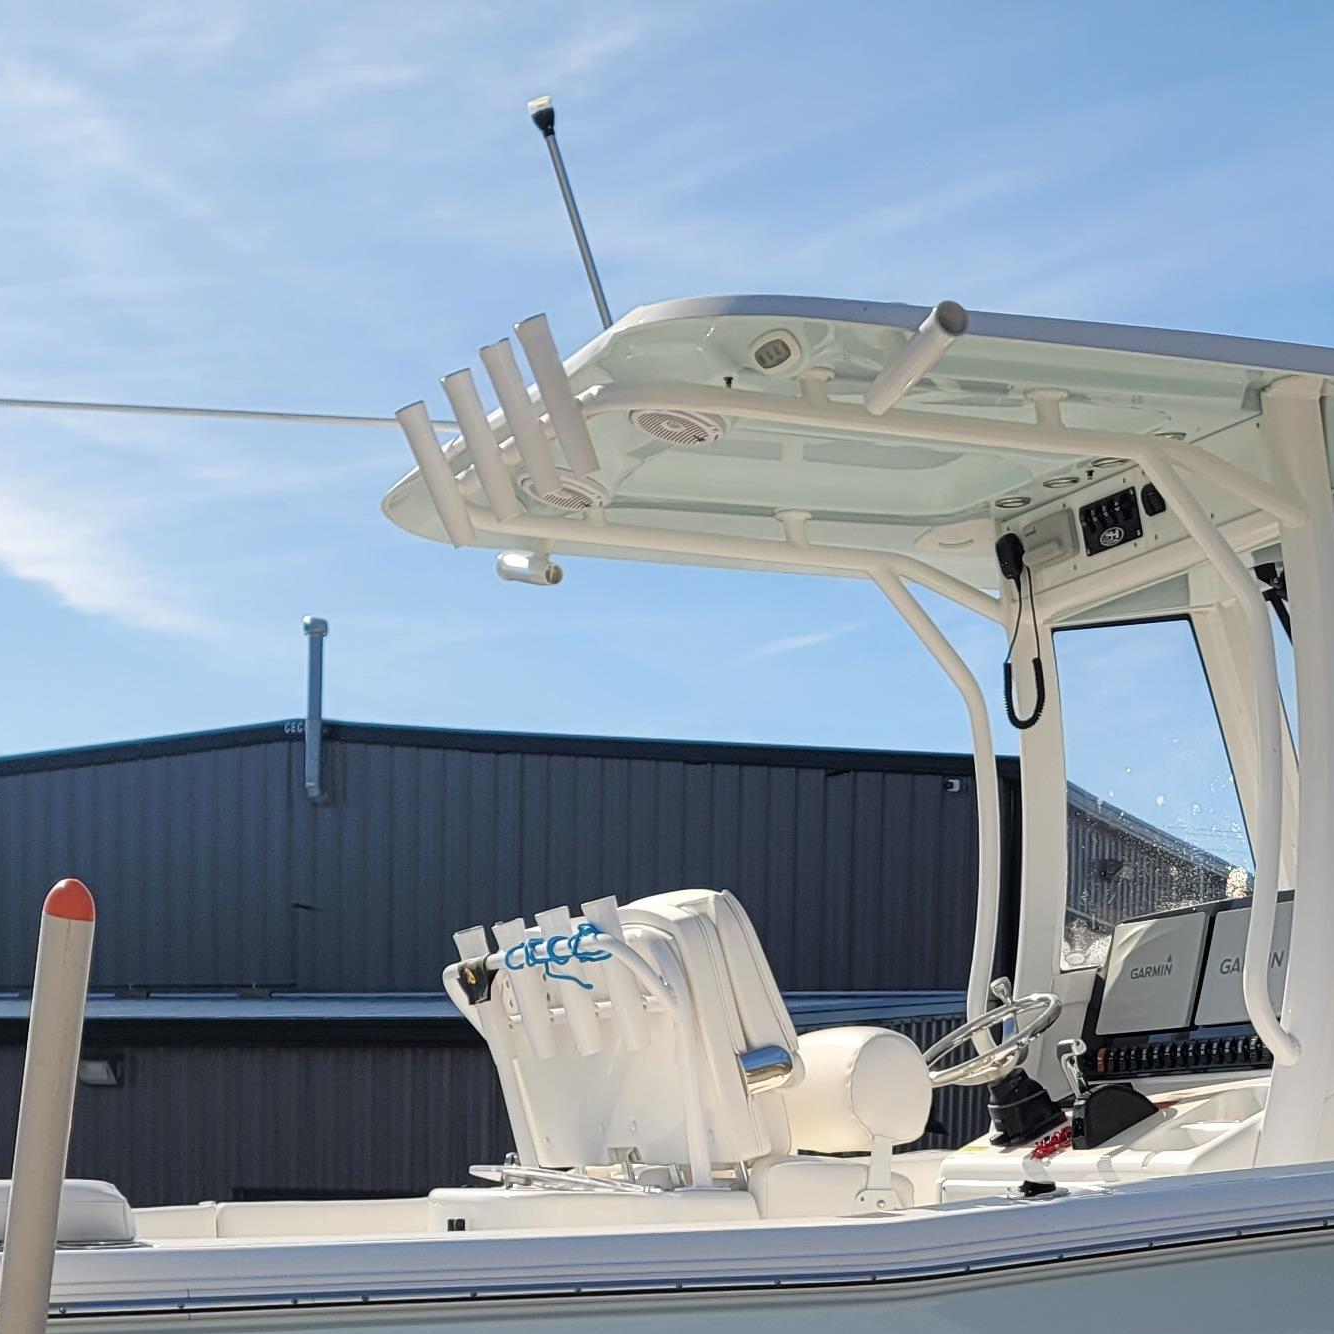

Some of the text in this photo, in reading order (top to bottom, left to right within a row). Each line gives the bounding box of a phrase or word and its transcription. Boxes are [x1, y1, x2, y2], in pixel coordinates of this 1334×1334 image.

[284, 722, 304, 734] CEC
[1220, 950, 1284, 975] GAIN
[1130, 963, 1173, 980] GARMIN
